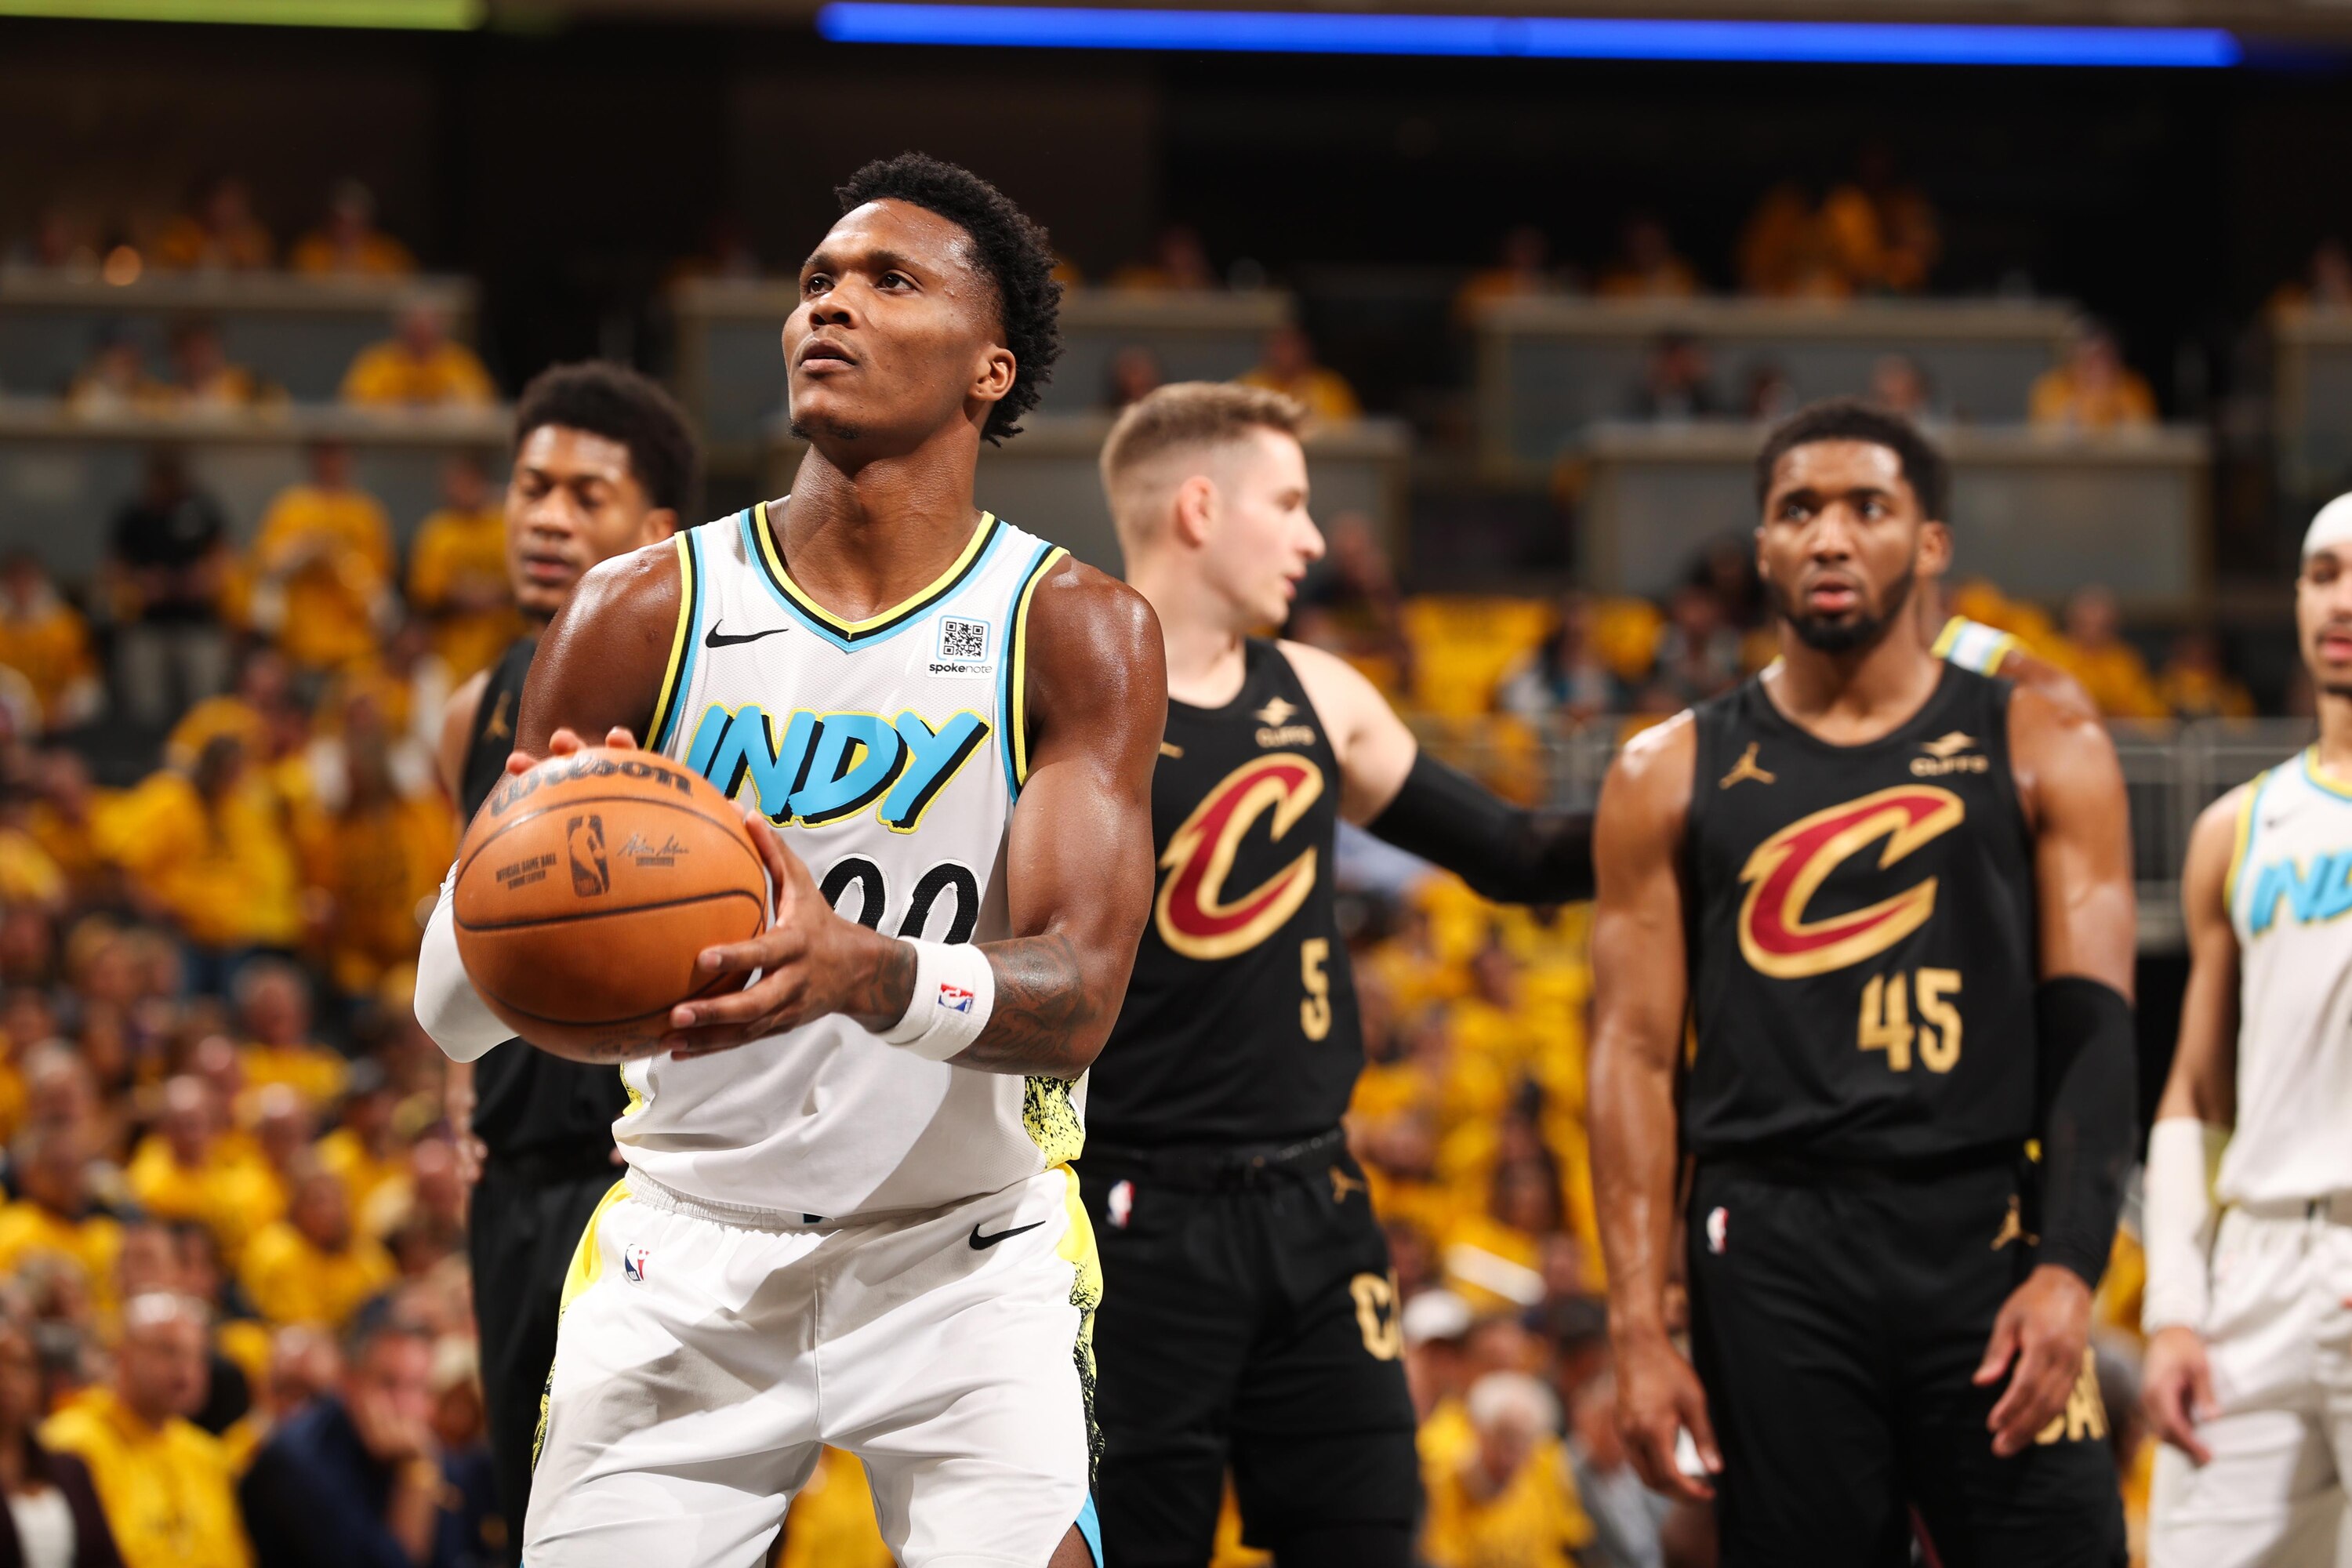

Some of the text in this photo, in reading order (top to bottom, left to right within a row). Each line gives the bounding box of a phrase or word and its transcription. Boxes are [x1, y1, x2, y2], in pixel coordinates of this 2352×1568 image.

[929, 662, 993, 674] spokenote
[681, 701, 993, 834] INDY
[1156, 752, 1323, 960] C
[1737, 784, 1965, 979] C
[1301, 938, 1330, 1041] 5
[1857, 967, 1962, 1073] 45
